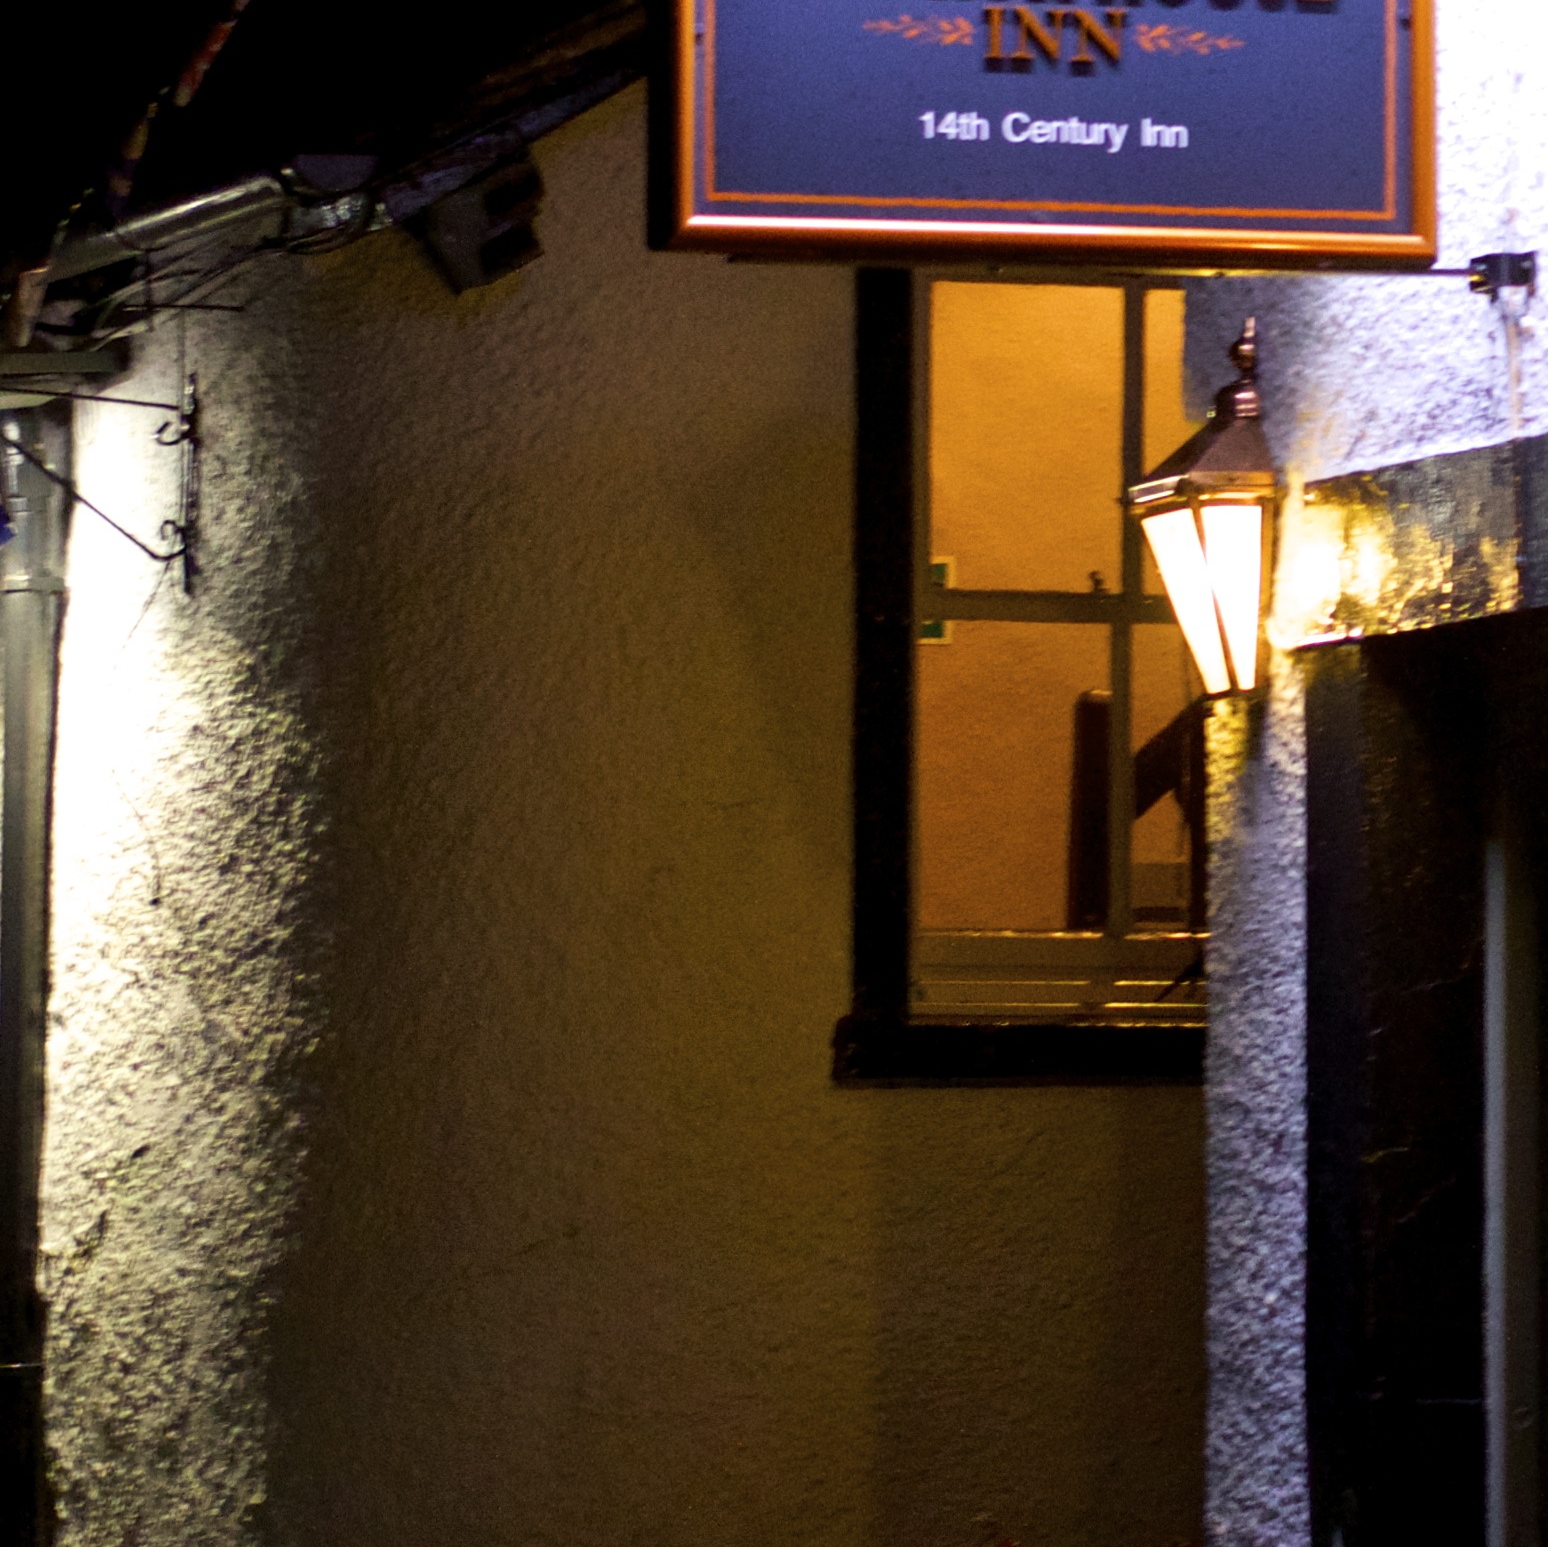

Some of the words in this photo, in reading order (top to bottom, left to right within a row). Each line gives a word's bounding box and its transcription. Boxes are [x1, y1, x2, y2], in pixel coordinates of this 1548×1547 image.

[982, 5, 1127, 63] INN
[918, 112, 989, 142] 14th
[1001, 112, 1128, 154] Century
[1140, 118, 1189, 149] Inn
